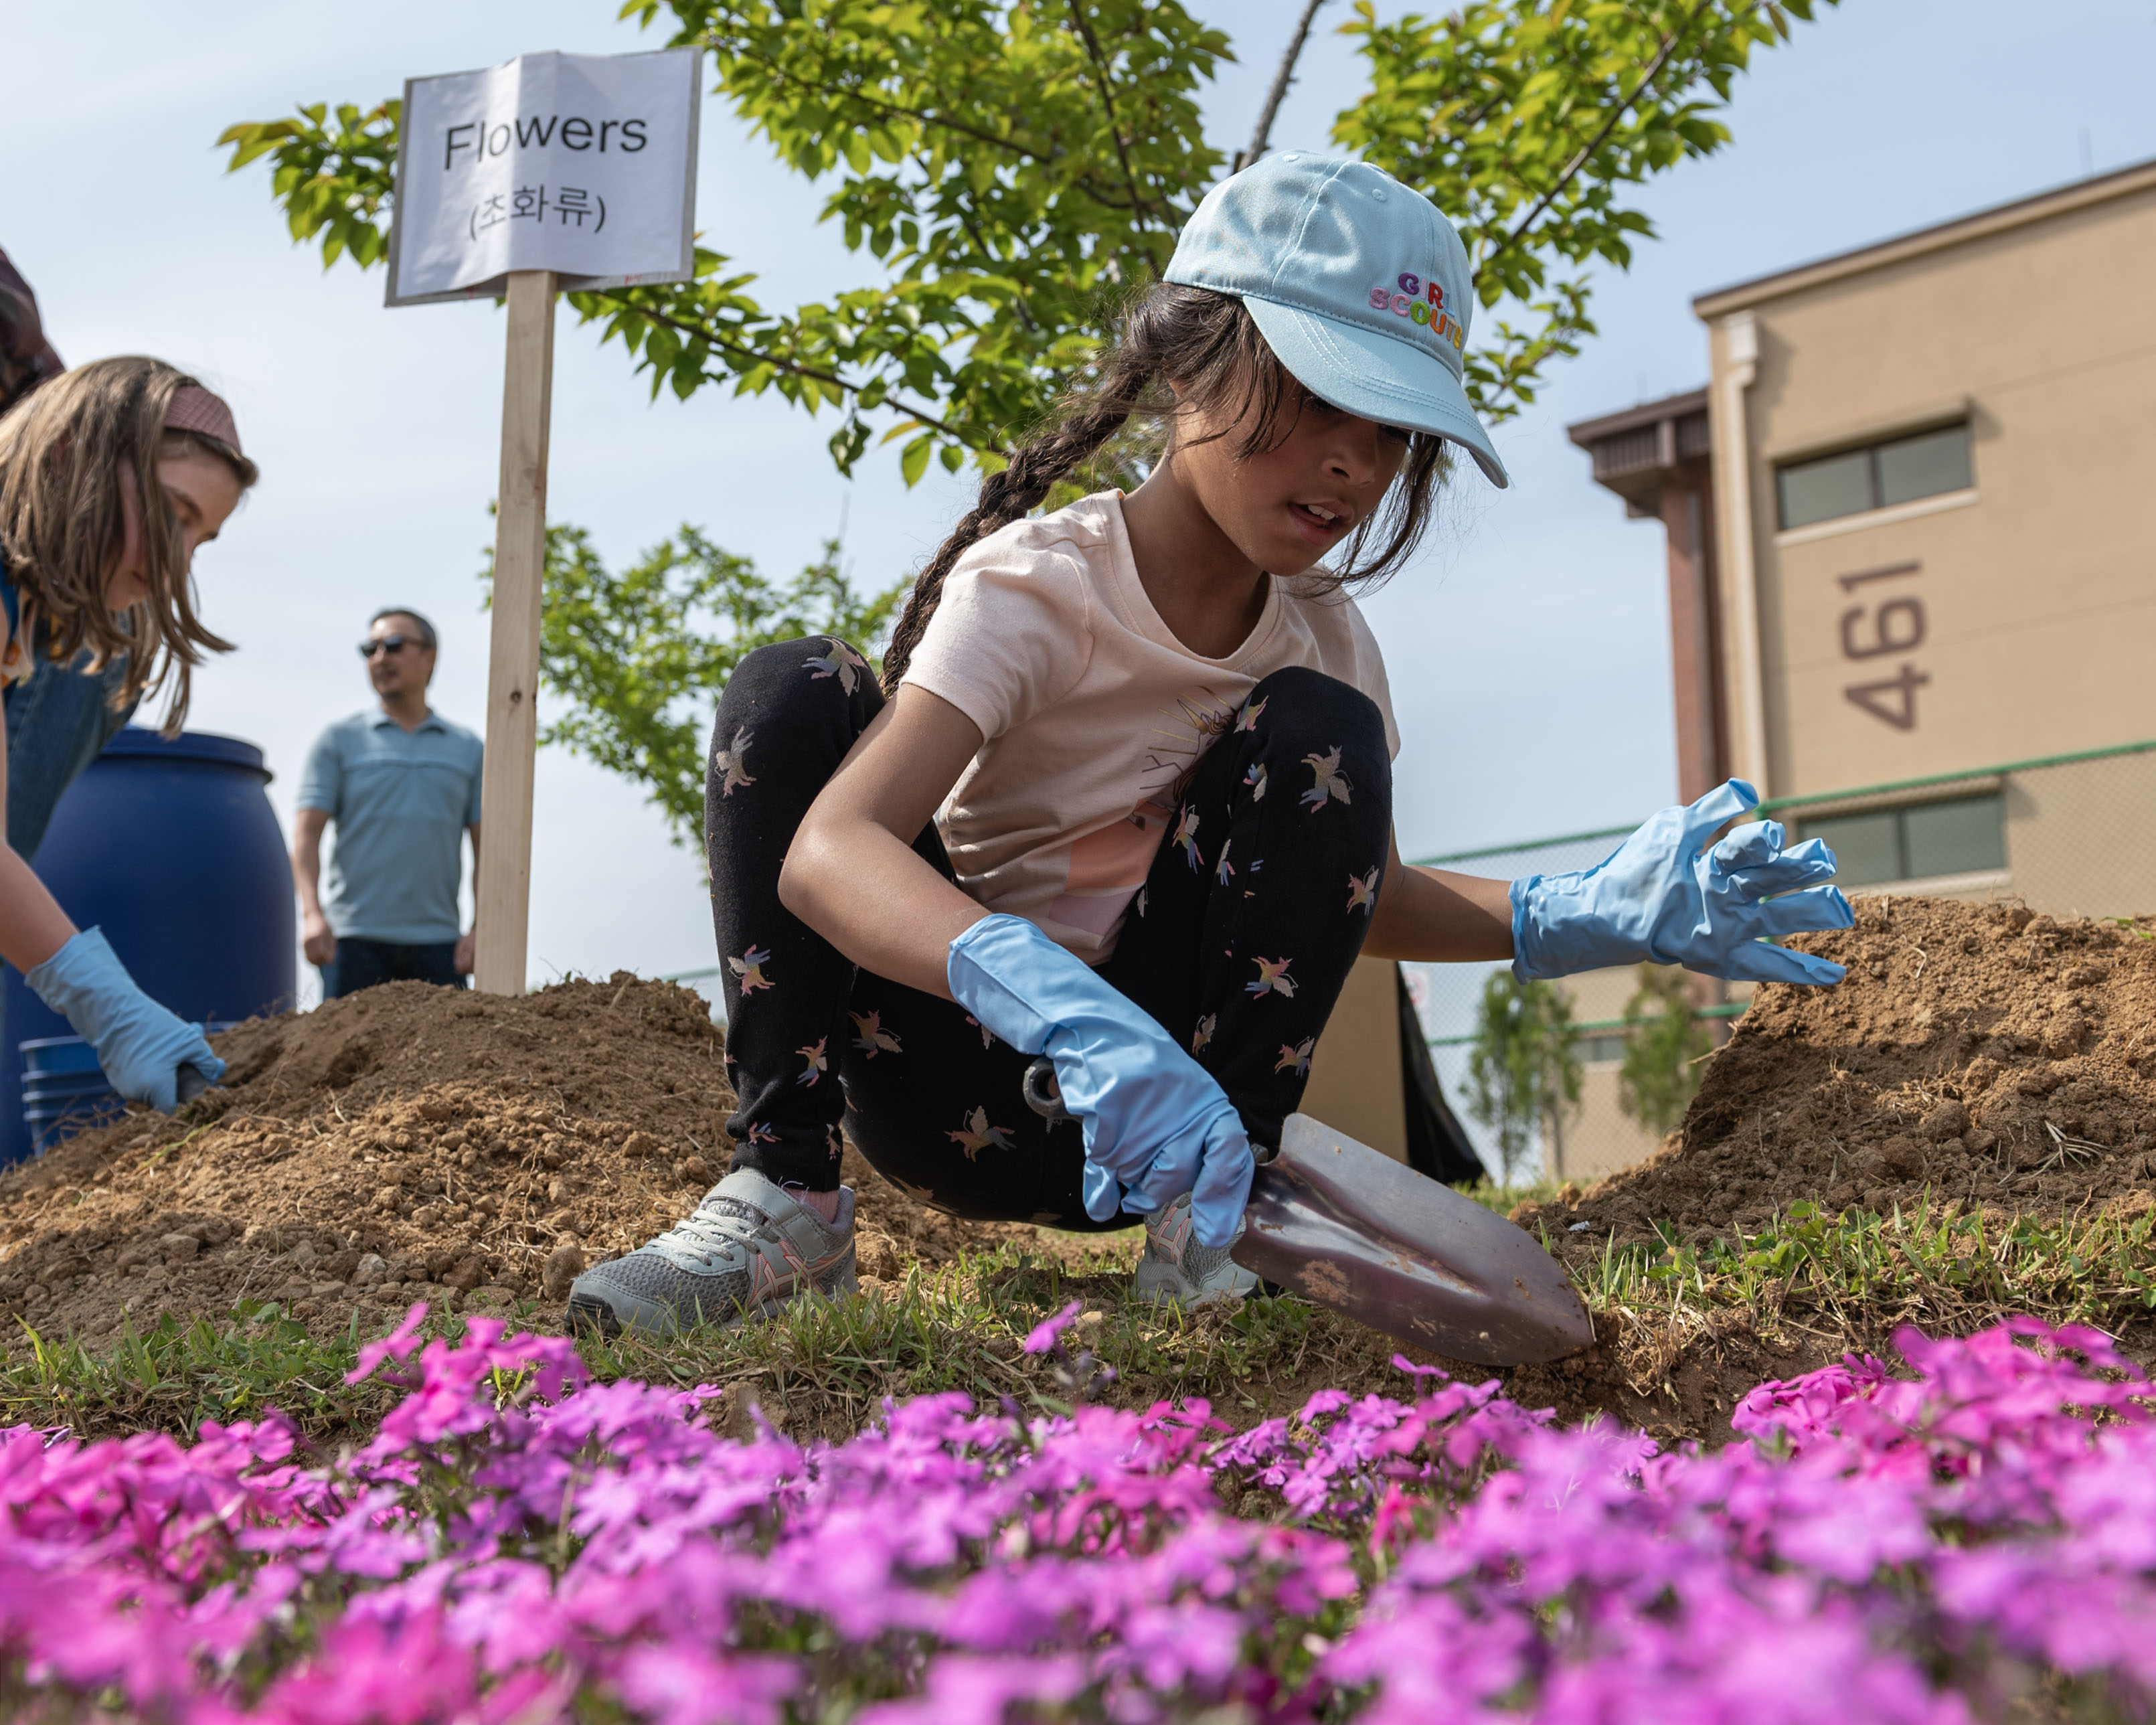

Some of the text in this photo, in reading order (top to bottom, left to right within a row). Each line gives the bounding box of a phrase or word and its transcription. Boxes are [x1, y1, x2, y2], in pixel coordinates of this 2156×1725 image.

[444, 115, 648, 171] Flowers
[469, 183, 606, 242] (초화류)
[1369, 287, 1463, 350] SCOUTS
[1837, 560, 1930, 731] 461
